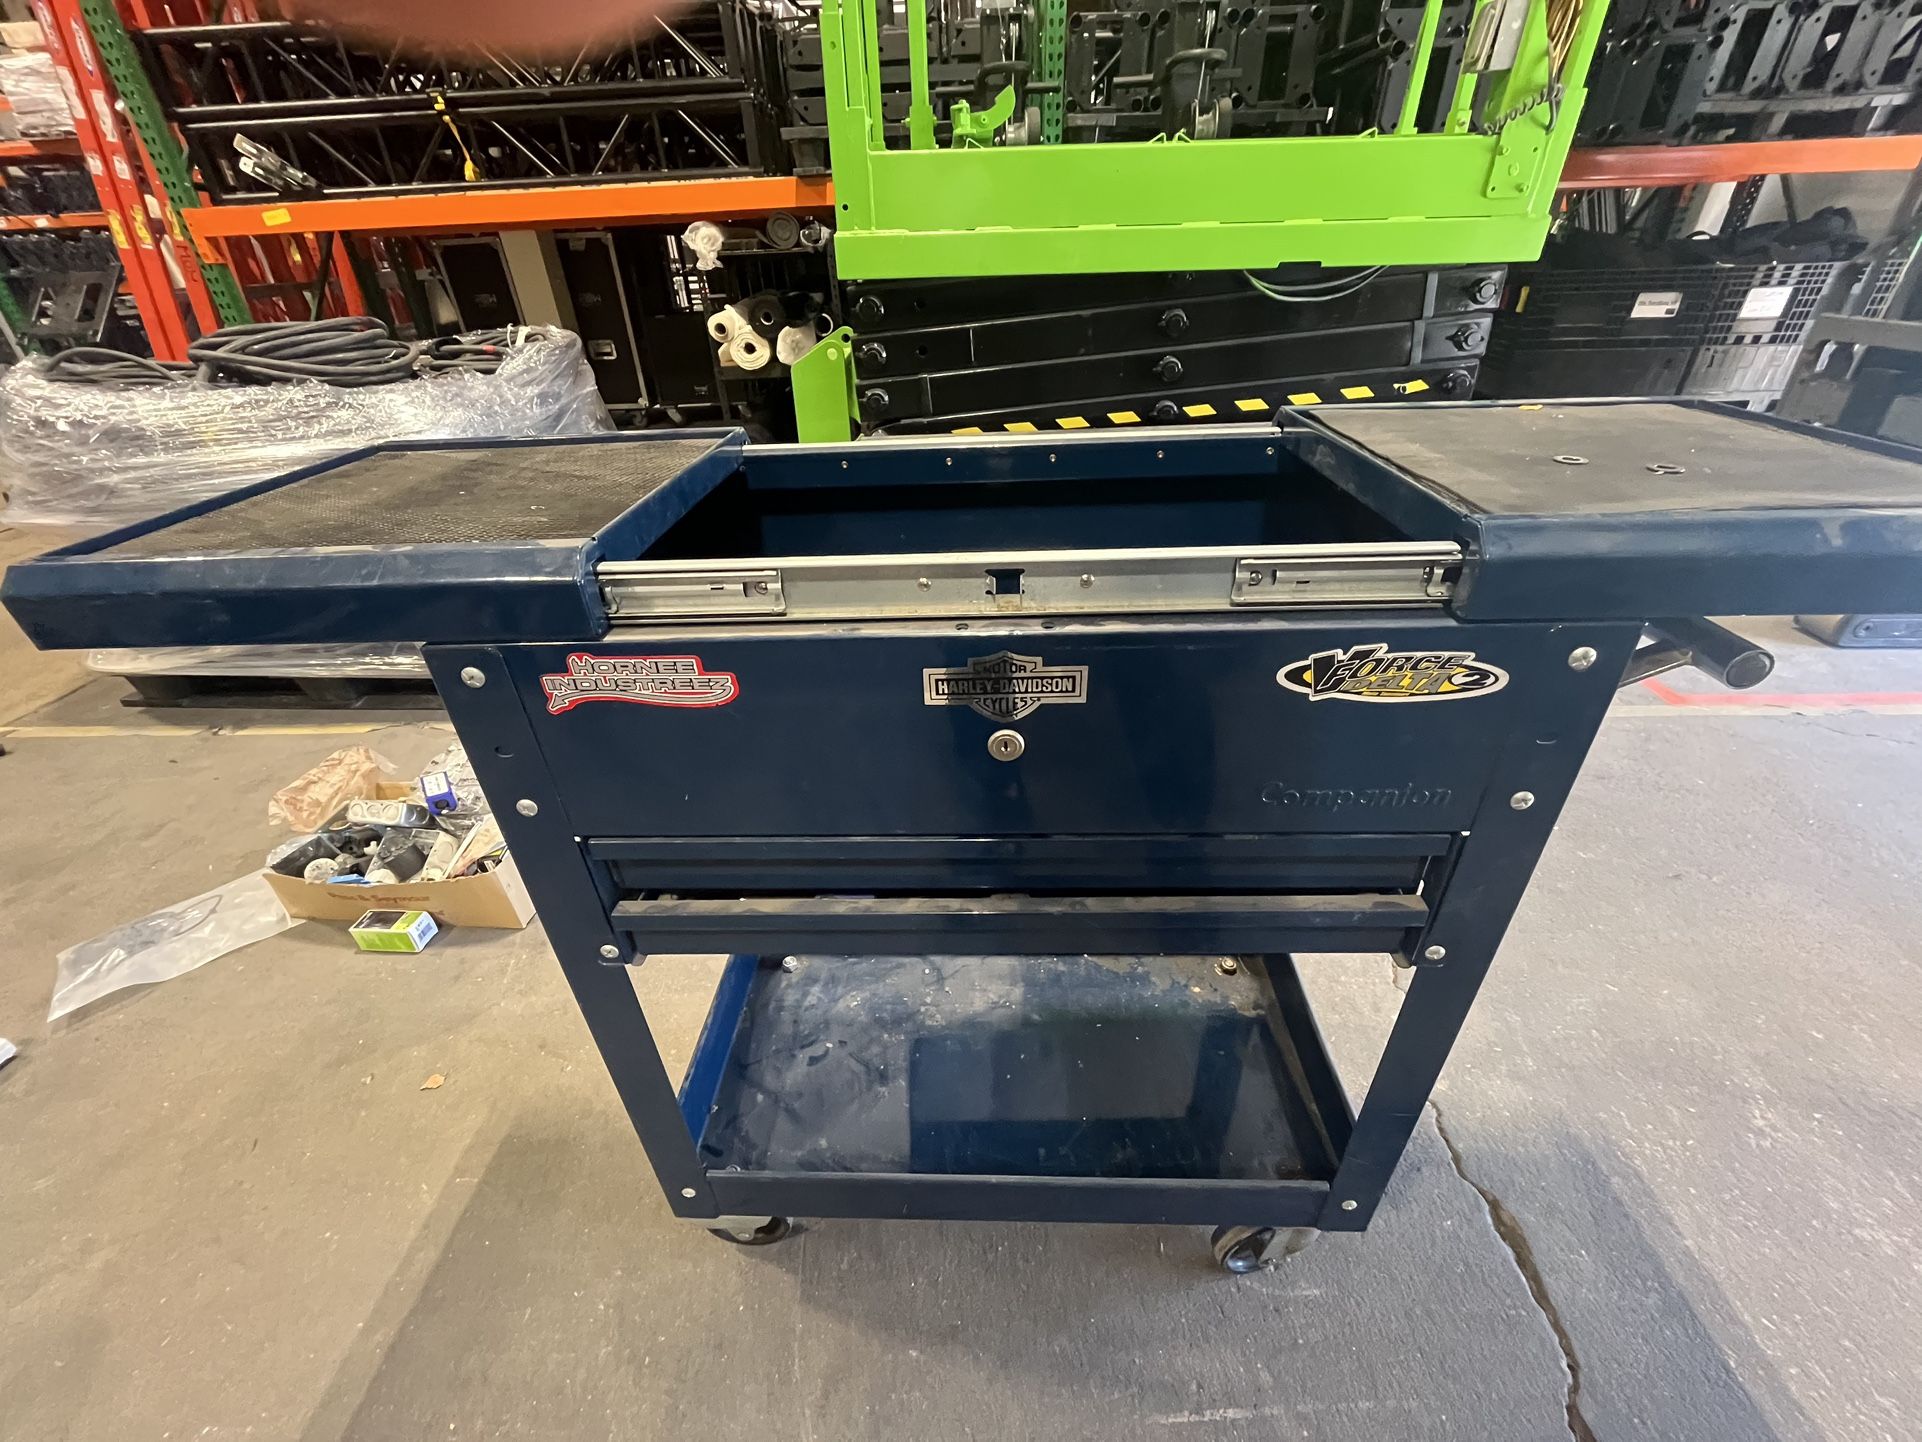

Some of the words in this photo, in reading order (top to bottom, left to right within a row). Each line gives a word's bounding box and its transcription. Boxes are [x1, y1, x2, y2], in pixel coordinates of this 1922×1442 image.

[571, 657, 697, 675] HORNEE
[981, 661, 1027, 674] MOTOR
[543, 676, 730, 693] INDUSTREEZ
[937, 678, 1074, 695] HARLEY-DAVIDSON
[1343, 671, 1449, 694] DELTA
[1456, 671, 1492, 688] 2
[983, 696, 1029, 714] CYCLES
[1260, 780, 1453, 812] Companion
